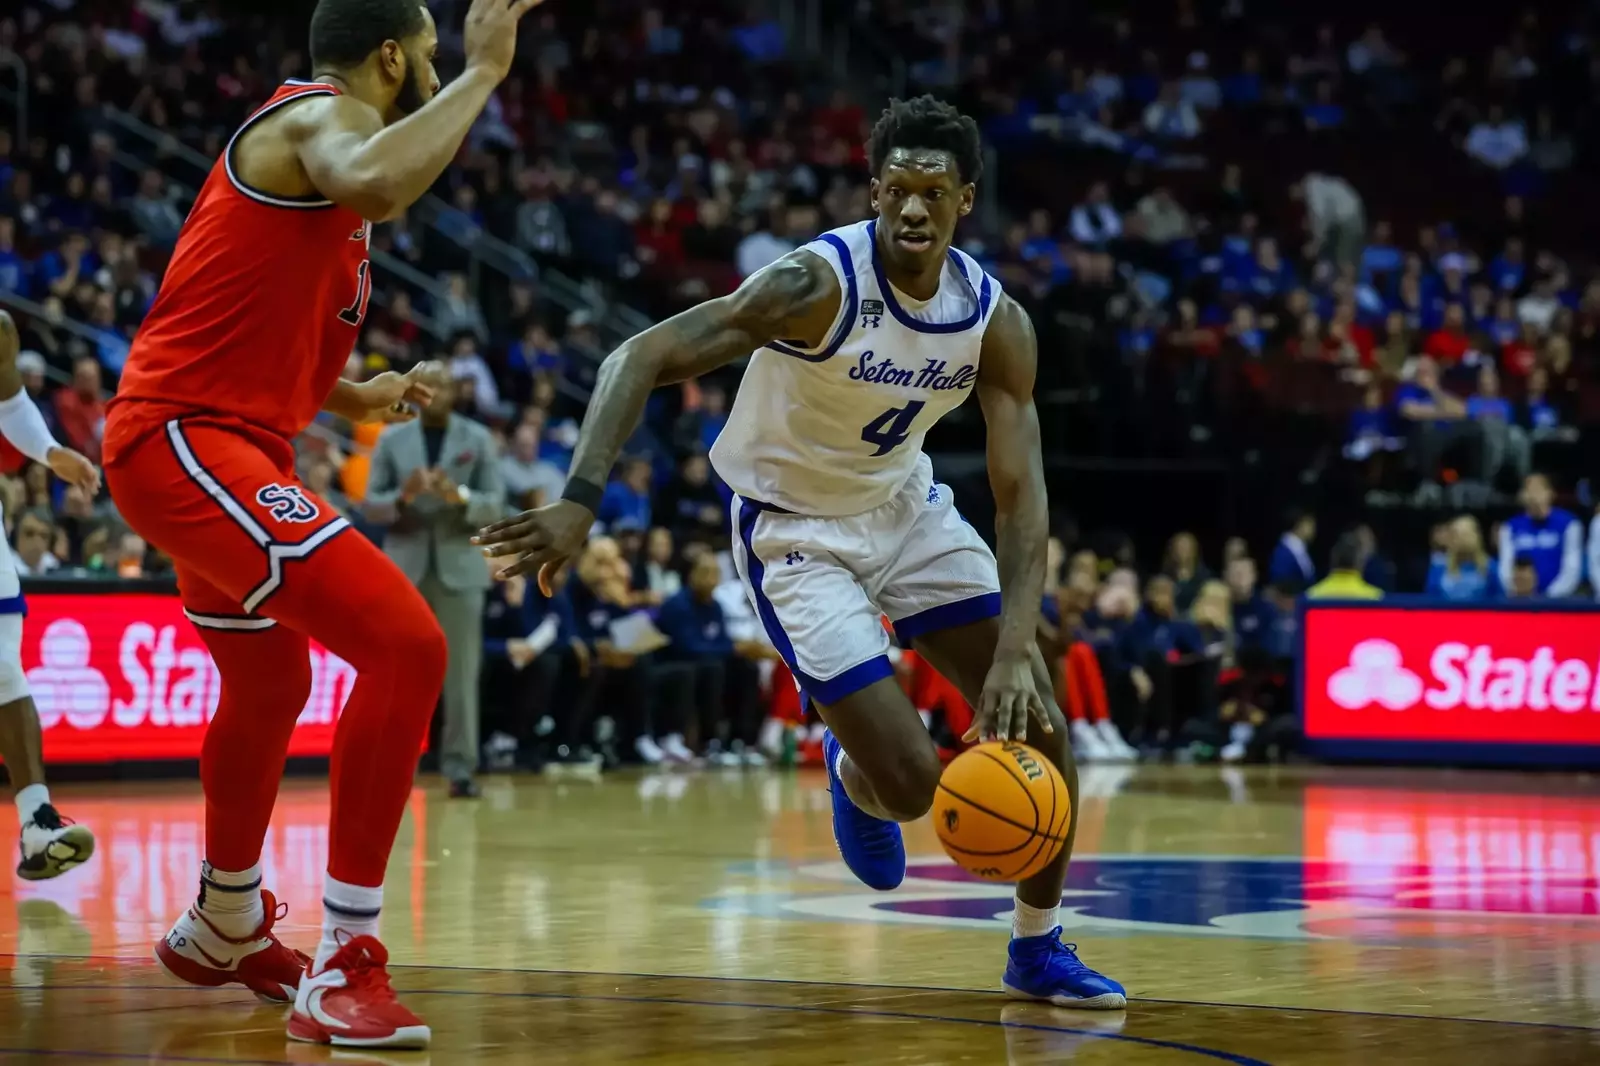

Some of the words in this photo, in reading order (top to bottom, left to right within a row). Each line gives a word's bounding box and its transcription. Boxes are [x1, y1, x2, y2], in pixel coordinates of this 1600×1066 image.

[337, 259, 371, 326] 1
[848, 350, 914, 387] Seton
[913, 357, 979, 390] Hall
[860, 400, 926, 457] 4
[112, 621, 221, 727] Sta
[1424, 641, 1591, 713] State
